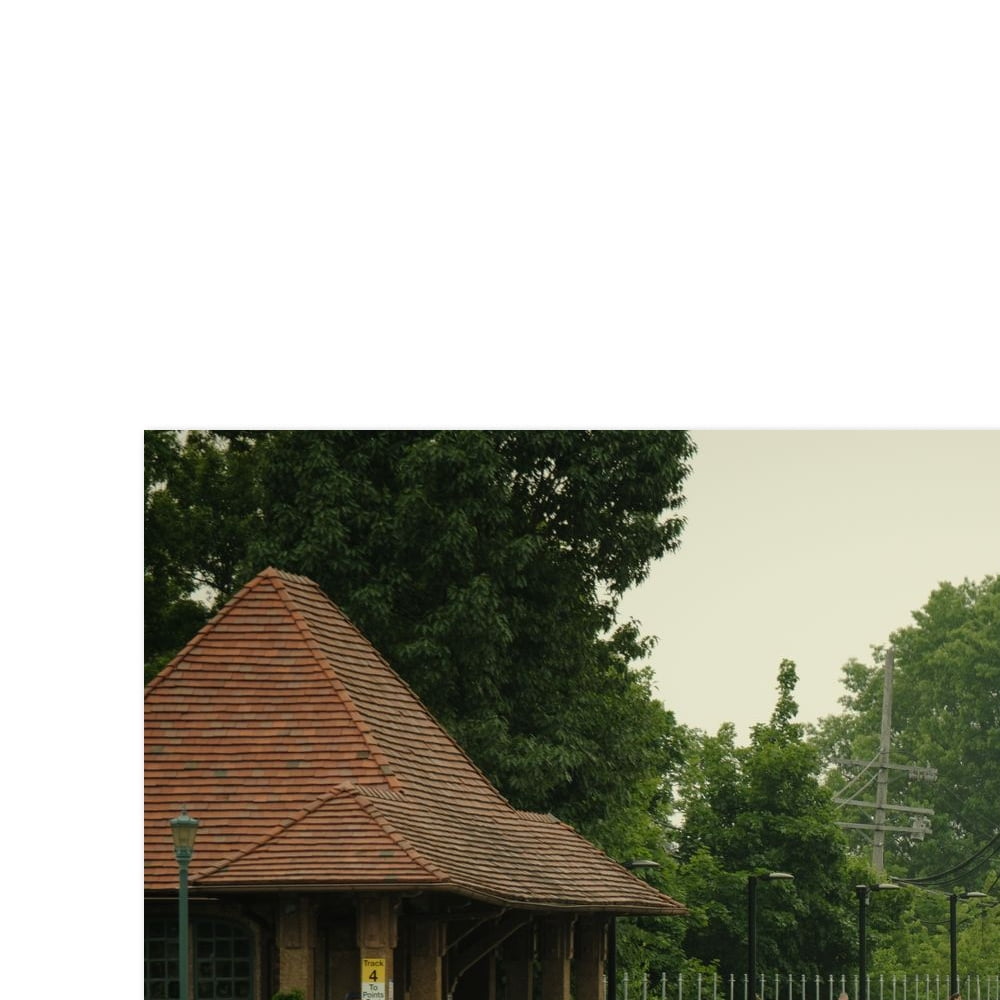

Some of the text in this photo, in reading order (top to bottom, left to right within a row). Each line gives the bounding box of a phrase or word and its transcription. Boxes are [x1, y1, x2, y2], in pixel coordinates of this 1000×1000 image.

[364, 959, 384, 967] Track
[368, 969, 379, 982] 4
[369, 983, 378, 991] To
[362, 991, 384, 999] Points
